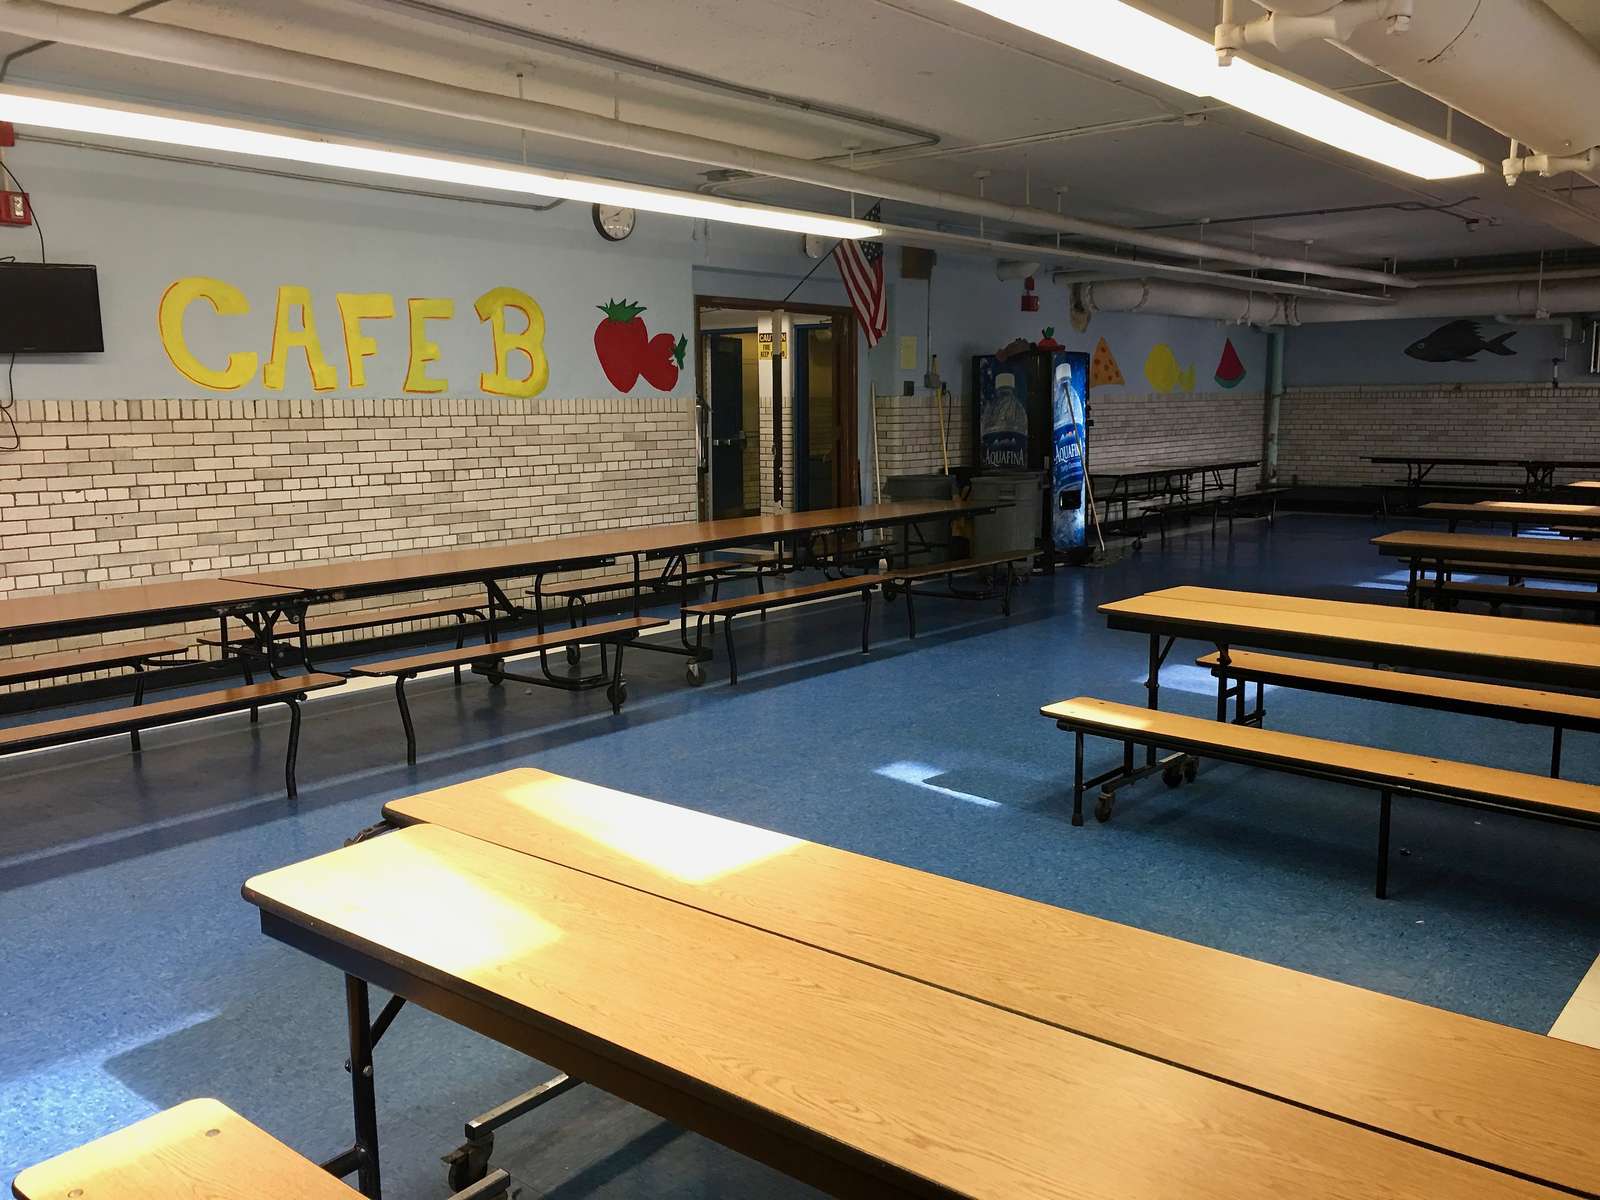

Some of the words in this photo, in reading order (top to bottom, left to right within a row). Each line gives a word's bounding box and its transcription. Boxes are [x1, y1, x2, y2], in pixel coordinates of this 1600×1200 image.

[157, 276, 455, 393] CAFE
[474, 286, 549, 398] B
[759, 334, 786, 342] CAUN
[983, 447, 1024, 466] AQUAFINA
[1054, 443, 1082, 464] AQUAFIN
